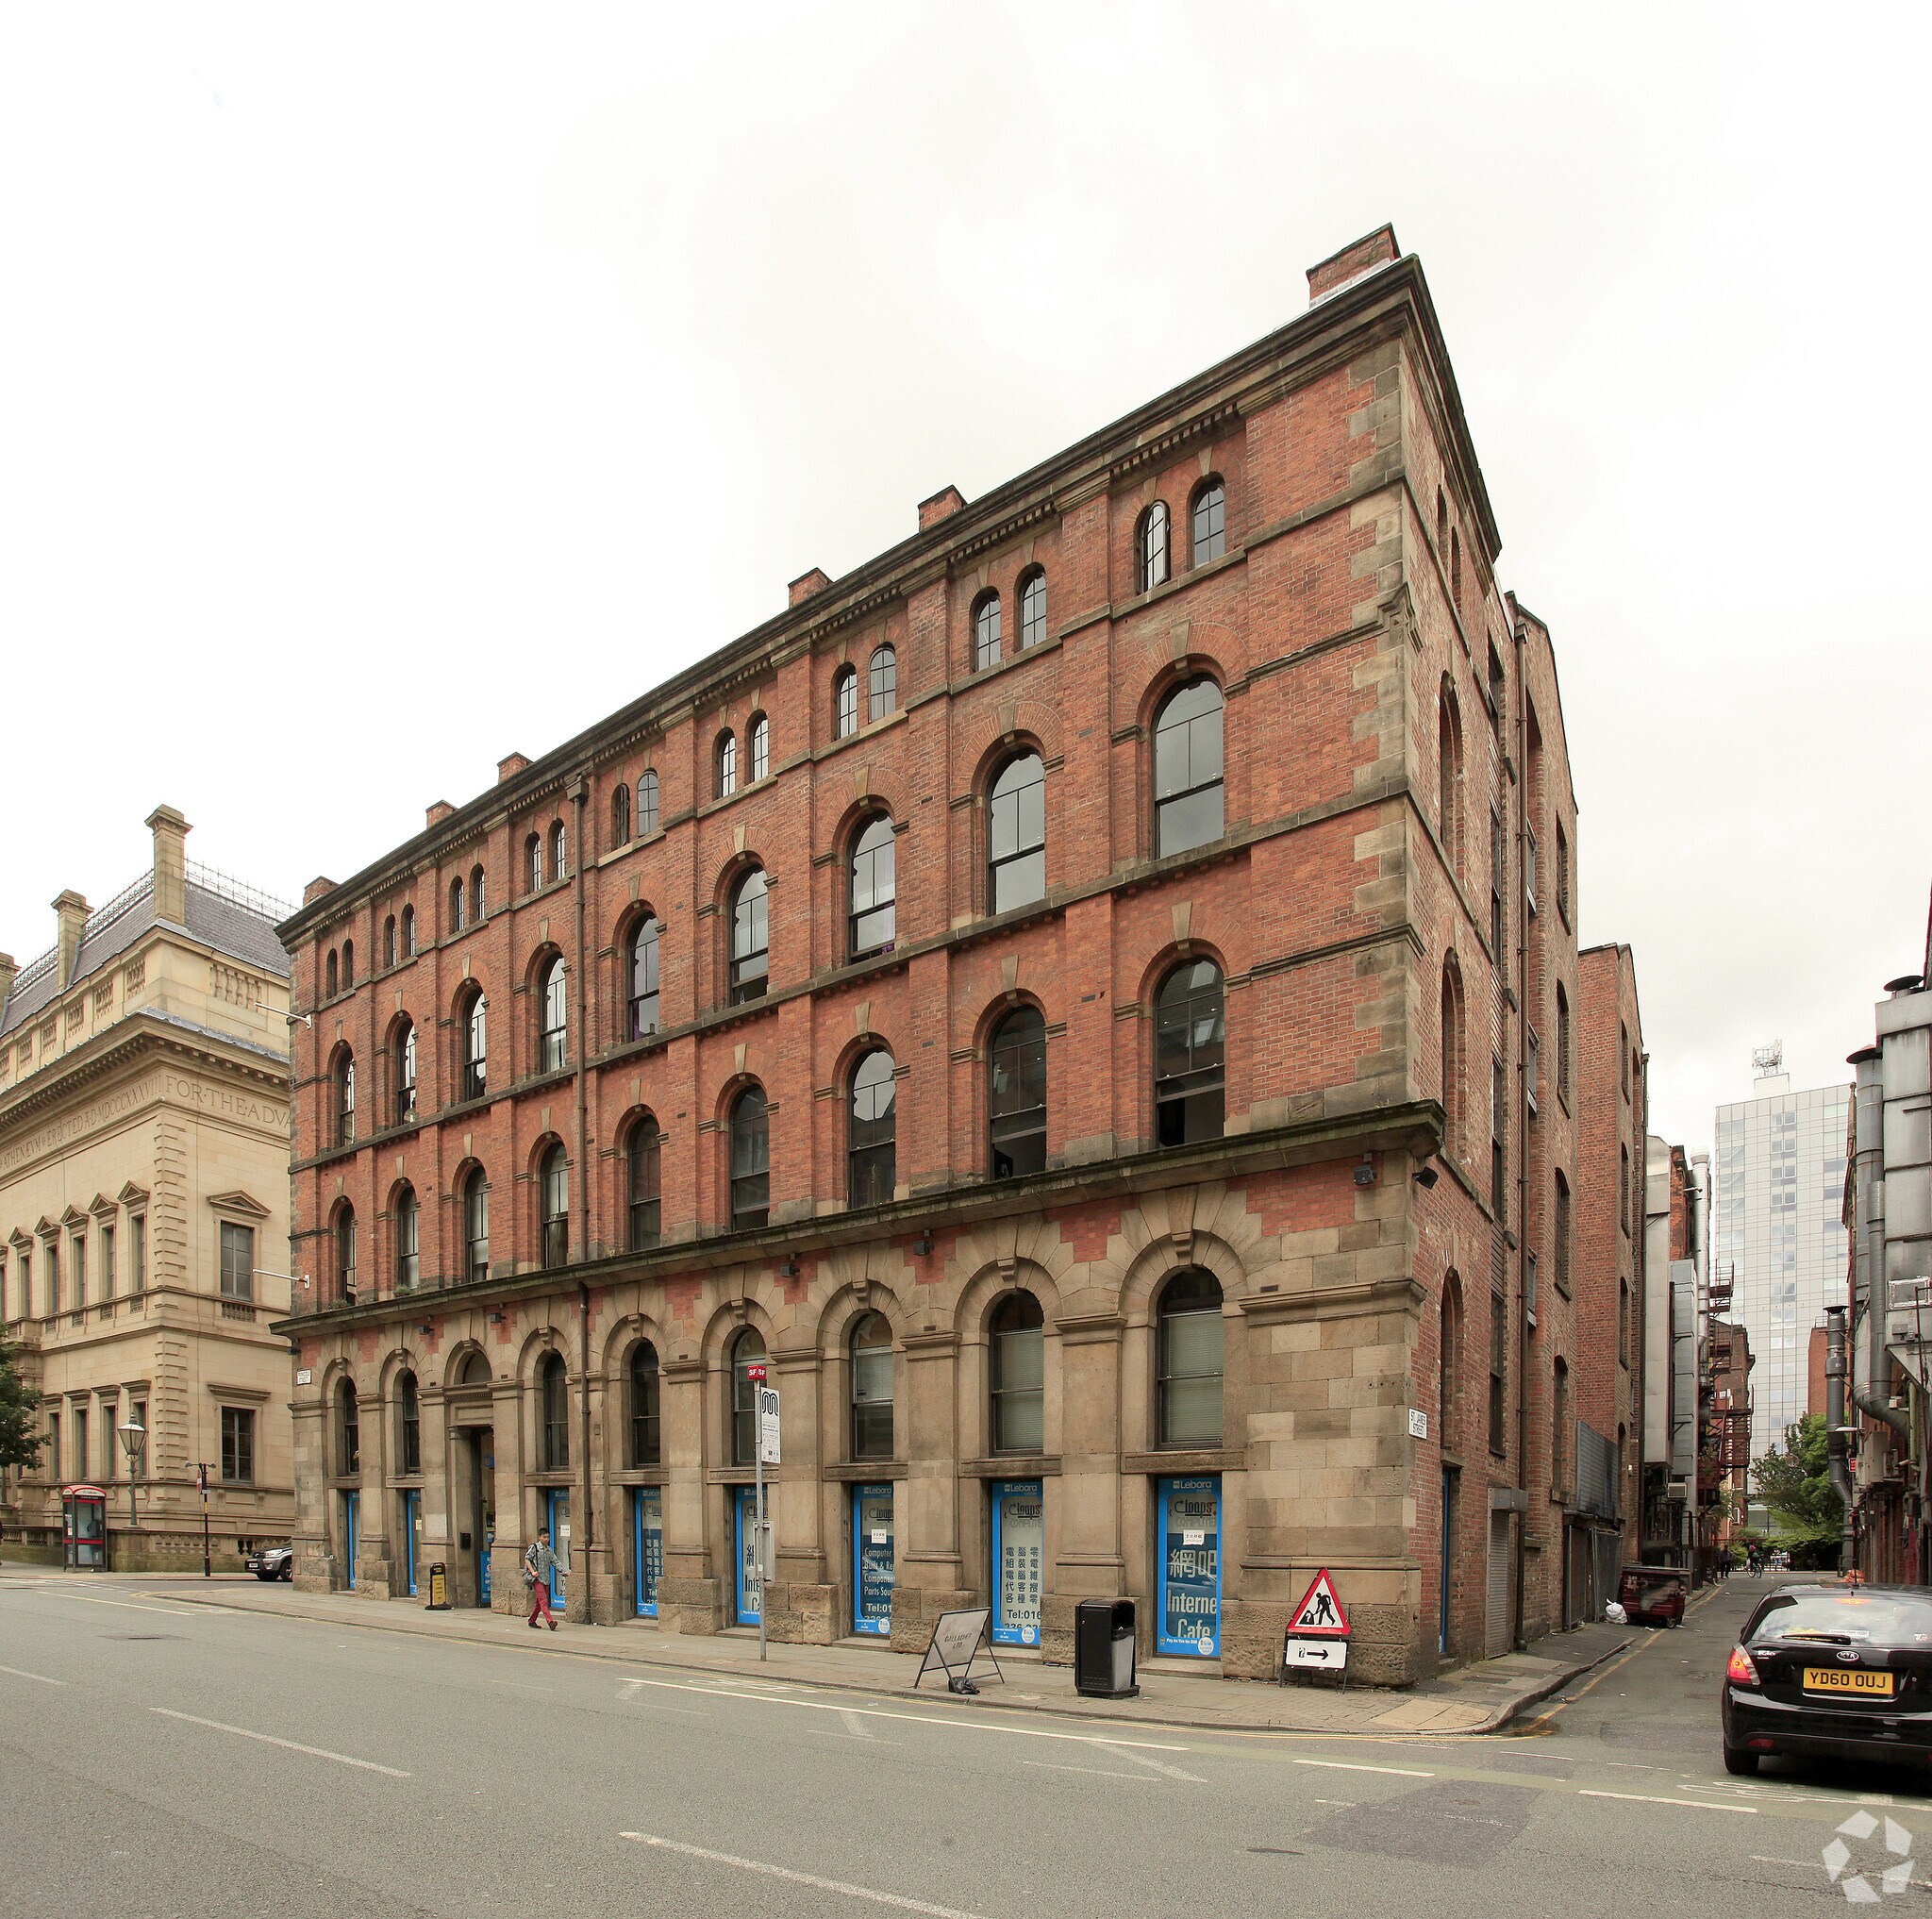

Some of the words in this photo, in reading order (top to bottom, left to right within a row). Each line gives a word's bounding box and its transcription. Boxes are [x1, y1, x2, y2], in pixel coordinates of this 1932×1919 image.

[166, 1076, 204, 1103] FOR
[207, 1088, 246, 1115] THE
[1010, 1484, 1038, 1493] Lebara
[1180, 1480, 1212, 1489] Lebara
[864, 1547, 892, 1559] Computer
[864, 1586, 879, 1595] Parts
[1177, 1618, 1210, 1638] Cafe
[1810, 1672, 1850, 1686] YD60
[1855, 1675, 1886, 1689] OUJ
